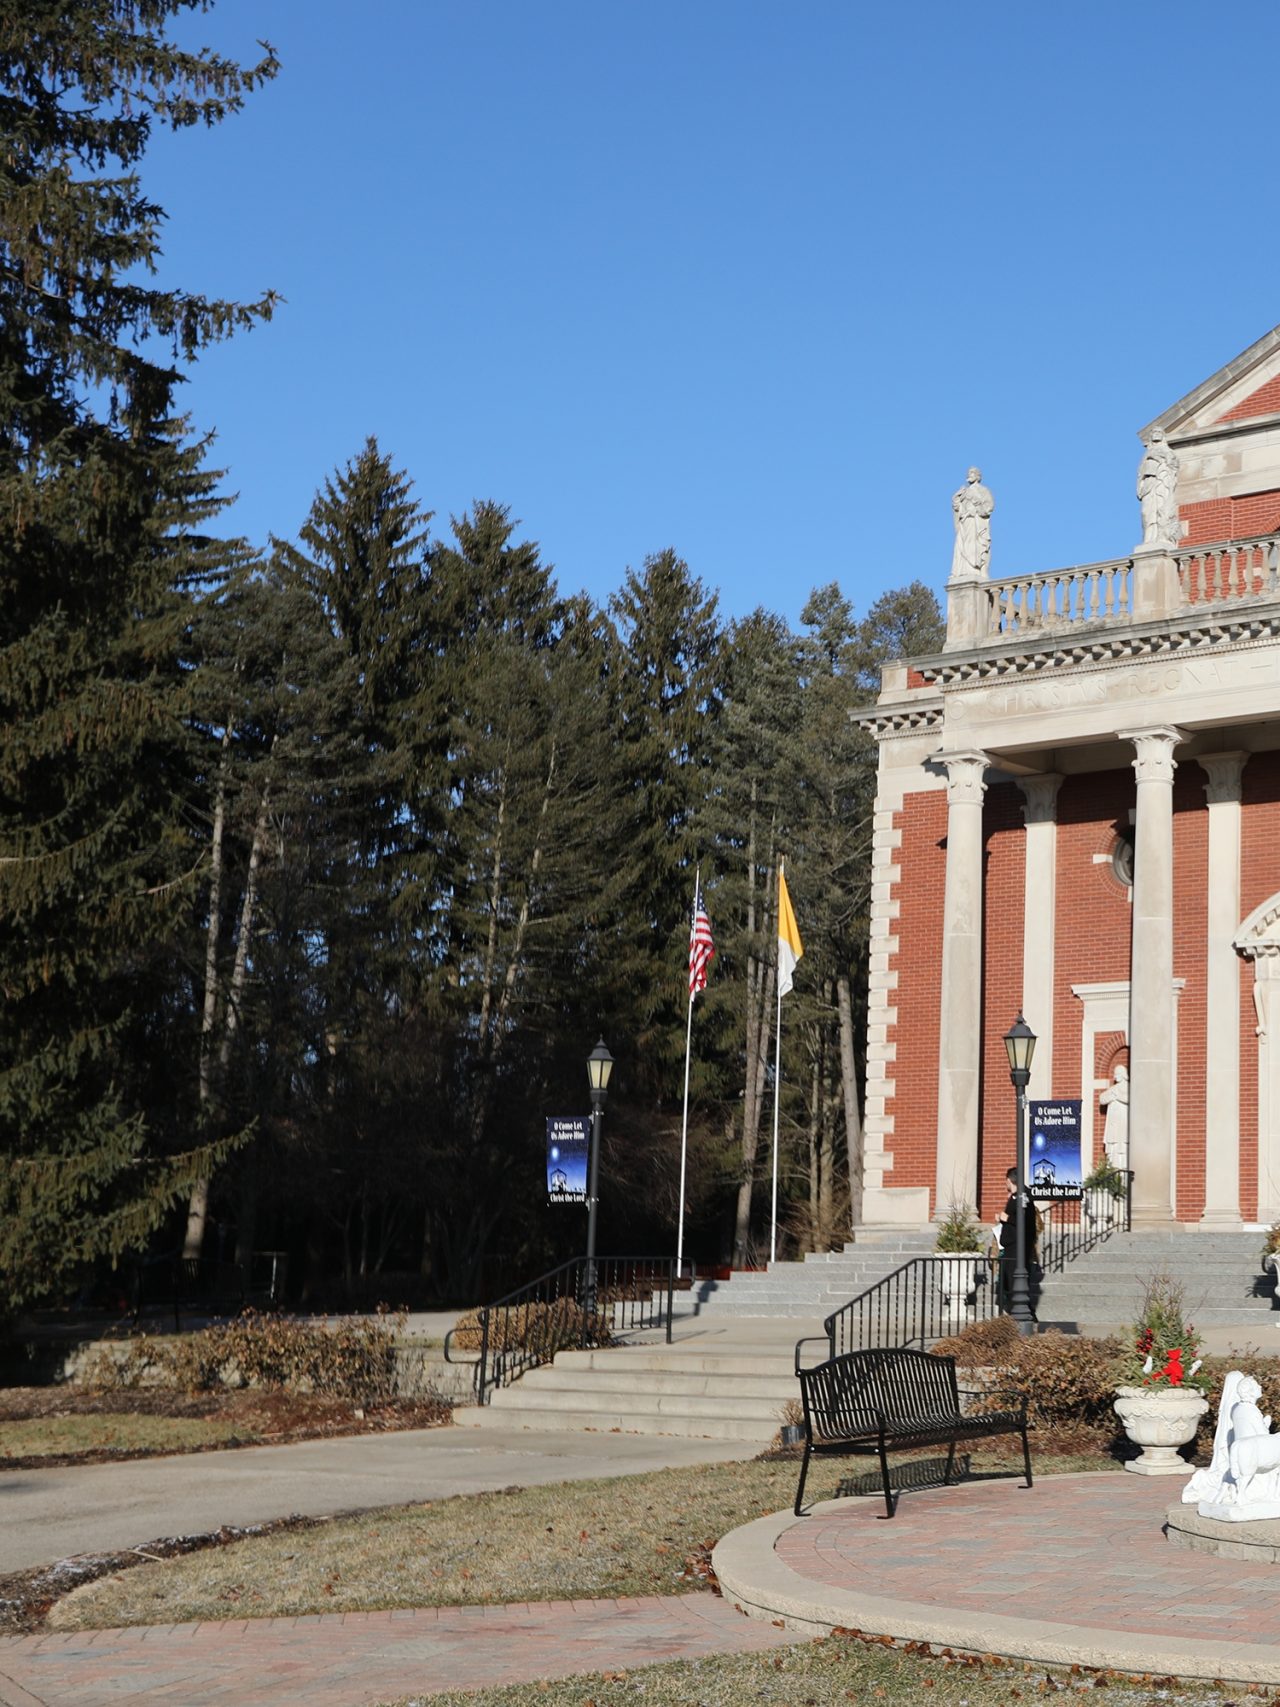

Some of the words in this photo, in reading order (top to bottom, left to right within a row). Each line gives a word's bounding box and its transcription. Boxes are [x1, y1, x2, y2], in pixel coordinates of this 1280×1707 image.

[1126, 660, 1240, 697] REGNAT
[1038, 1107, 1043, 1115] O
[1043, 1106, 1061, 1116] Come
[1061, 1106, 1072, 1115] Let
[558, 1121, 573, 1131] Come
[573, 1121, 583, 1130] Let
[1034, 1116, 1042, 1126] Us
[1042, 1116, 1062, 1126] Adore
[1062, 1116, 1076, 1125] Him
[551, 1131, 557, 1140] Us
[557, 1131, 573, 1140] Adore
[573, 1131, 585, 1140] Him
[1031, 1187, 1052, 1197] Christ
[1052, 1187, 1064, 1197] the
[1064, 1186, 1081, 1196] Lord
[550, 1193, 564, 1203] Christ
[564, 1193, 573, 1202] the
[573, 1193, 585, 1202] Lord
